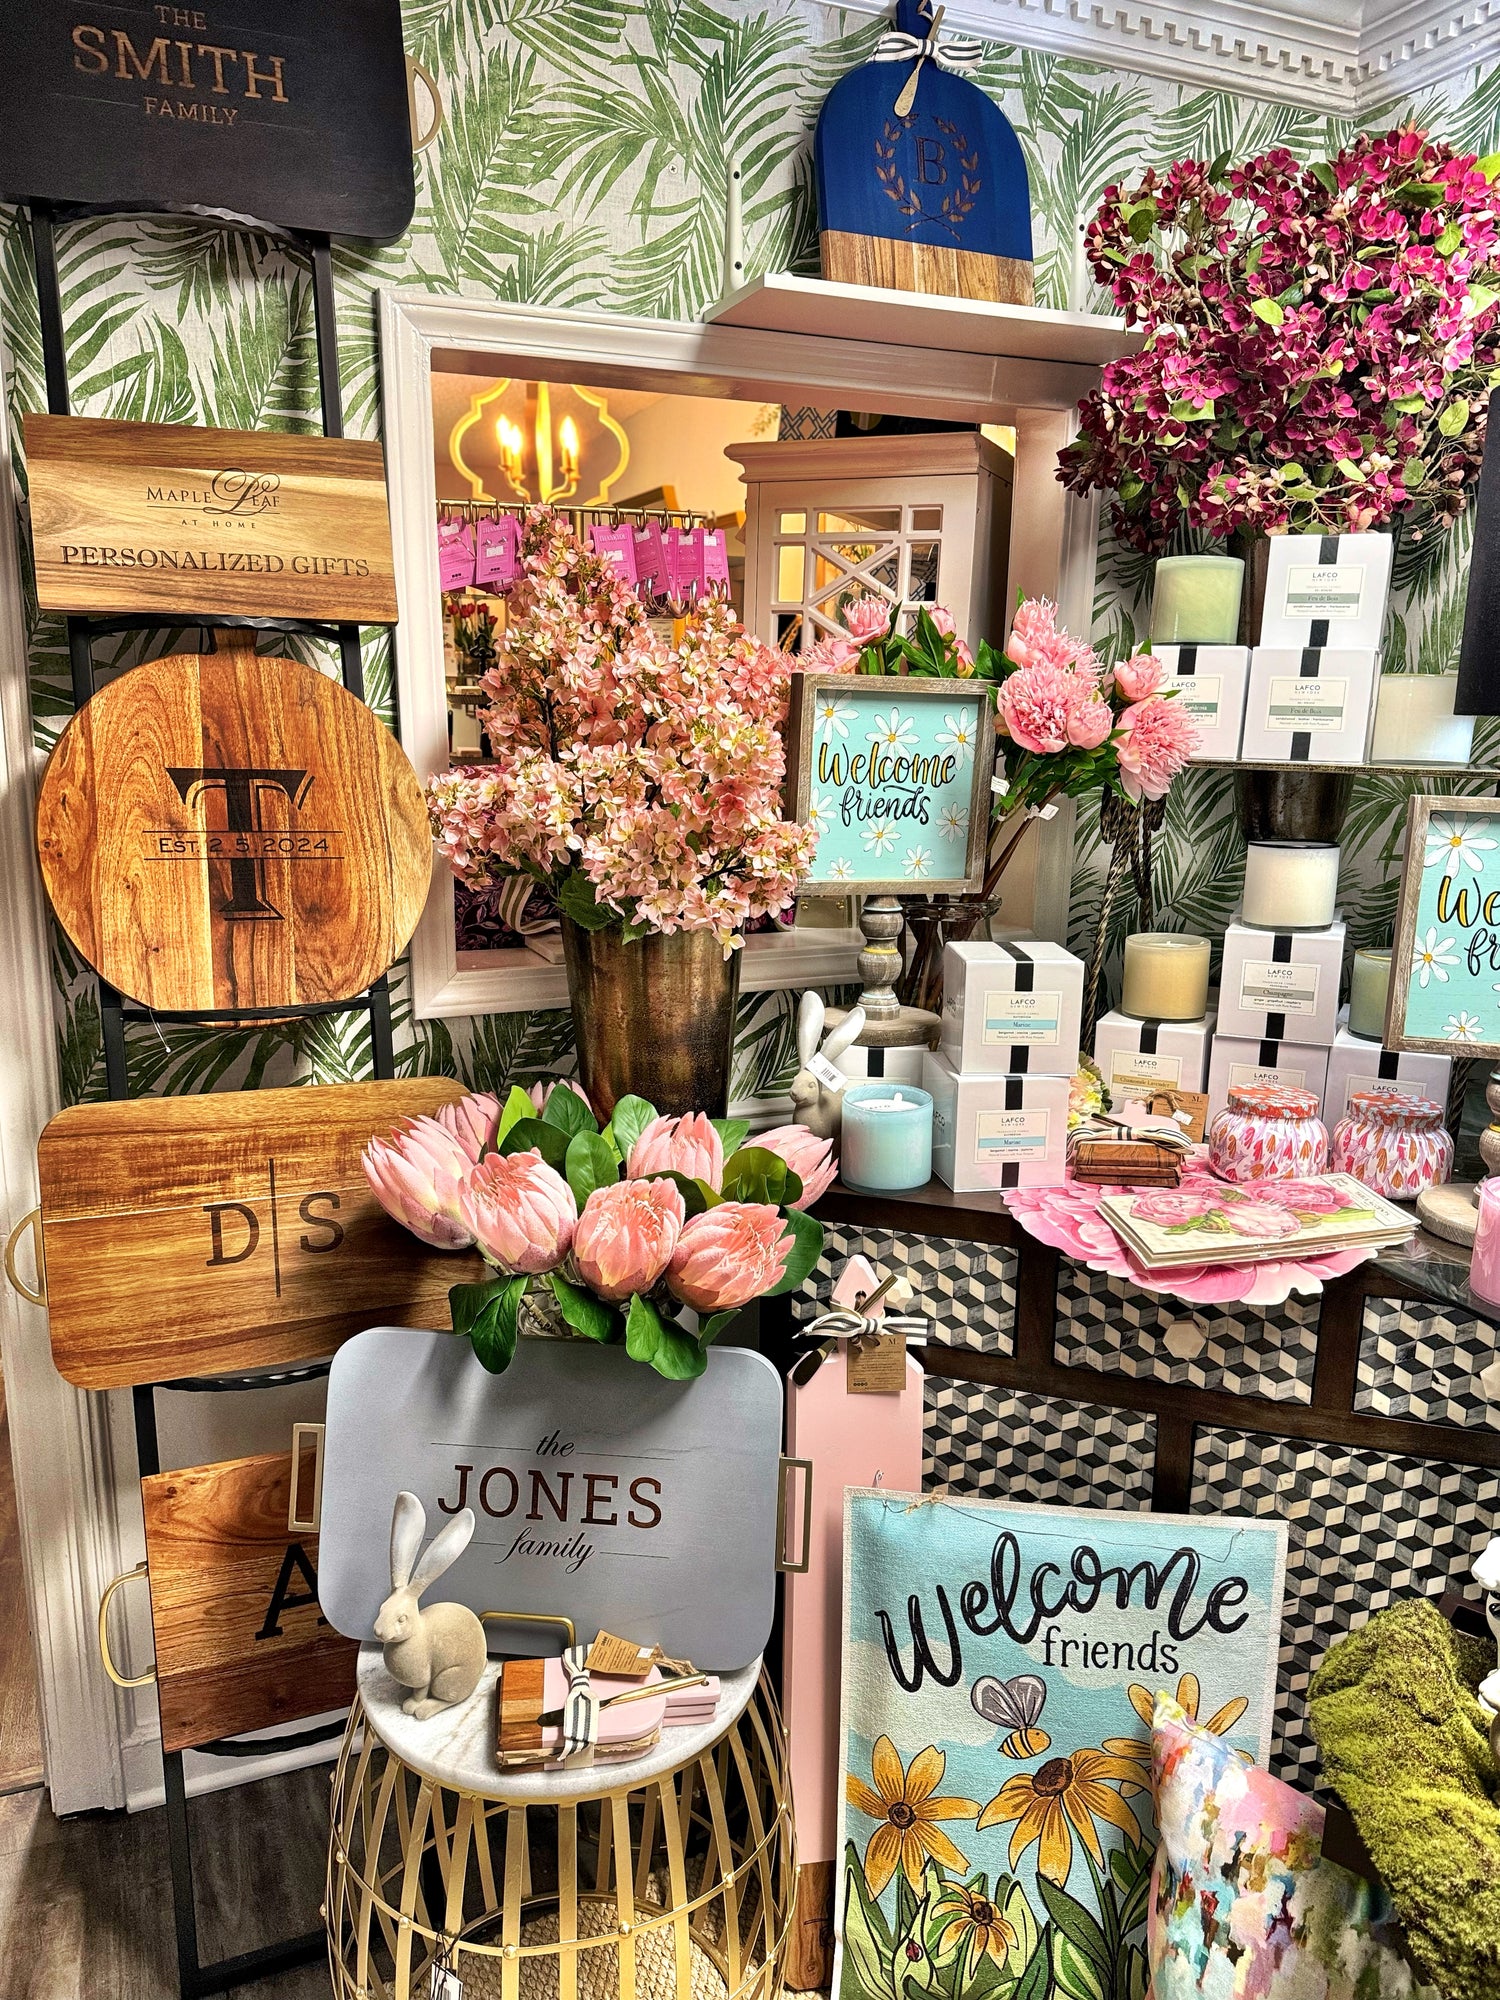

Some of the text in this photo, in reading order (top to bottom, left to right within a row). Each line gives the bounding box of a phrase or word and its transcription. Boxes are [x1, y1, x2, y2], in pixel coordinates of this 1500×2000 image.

[154, 5, 207, 30] THE
[71, 24, 290, 103] SMITH
[143, 97, 239, 127] FAMILY
[913, 136, 948, 186] B
[146, 467, 281, 517] MAPLE LEAF
[181, 519, 257, 529] AT HOME
[60, 545, 370, 577] PERSONALIZED GIFTS
[818, 741, 957, 790] Welcome
[839, 785, 931, 827] friends
[165, 767, 316, 921] T
[1134, 1059, 1158, 1067] LAFCO
[1372, 1084, 1398, 1093] LAFCO
[202, 1191, 345, 1267] D S
[535, 1430, 575, 1457] the
[437, 1464, 662, 1529] JONES
[494, 1526, 596, 1574] family
[874, 1531, 1250, 1693] Welcome
[1041, 1625, 1180, 1674] friends
